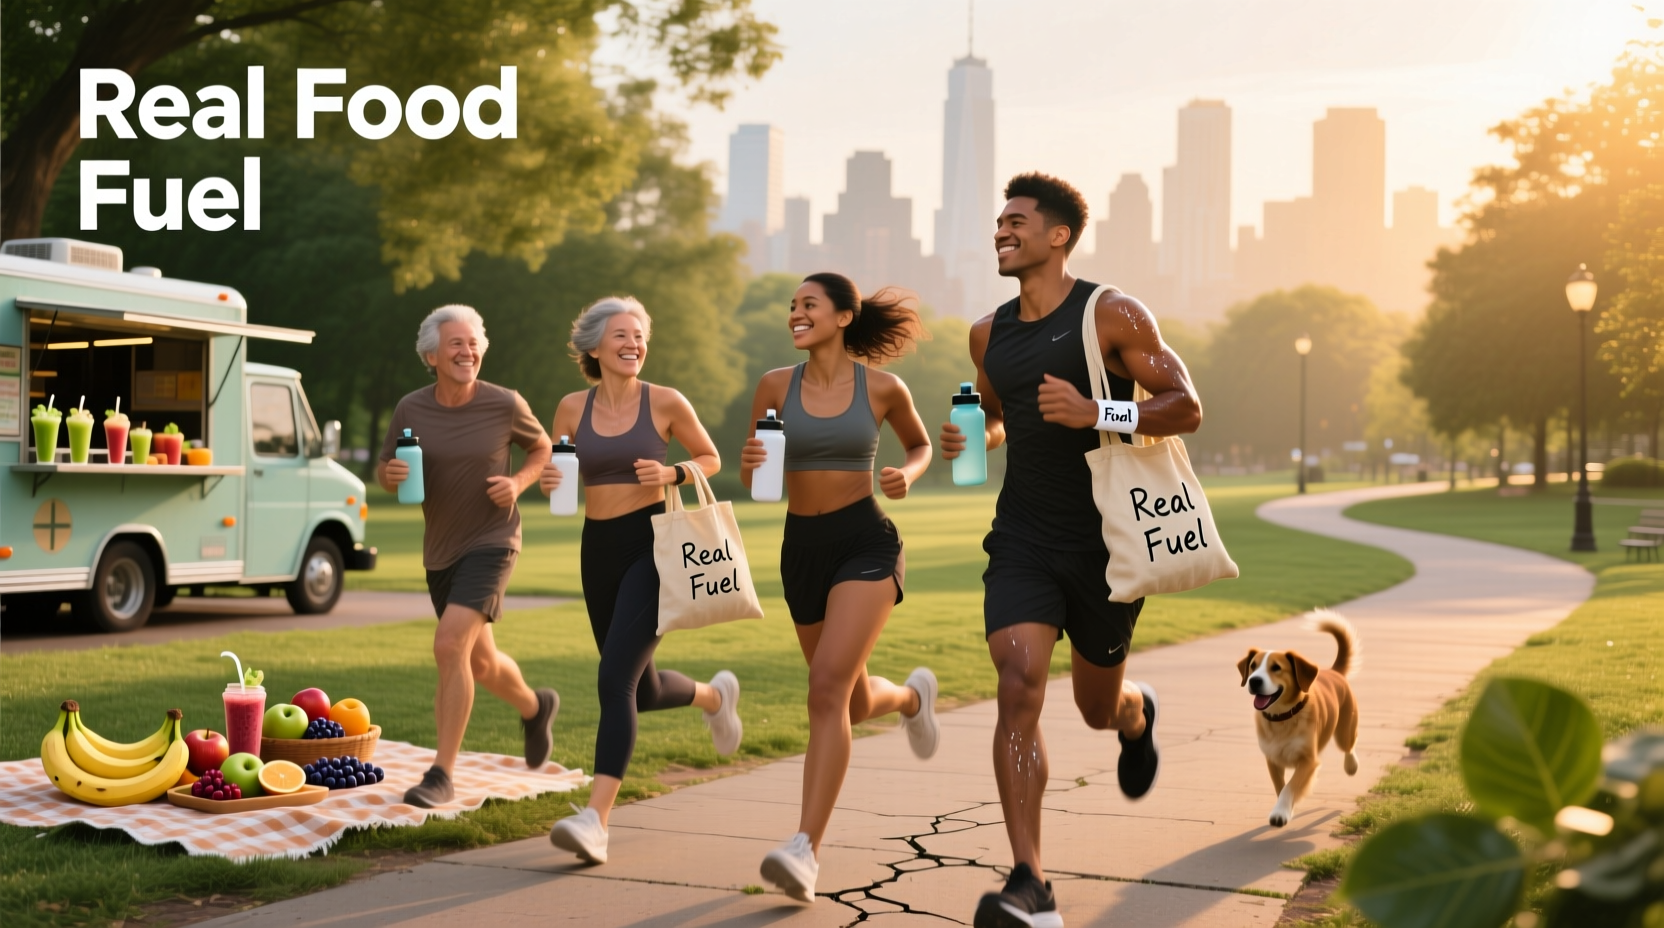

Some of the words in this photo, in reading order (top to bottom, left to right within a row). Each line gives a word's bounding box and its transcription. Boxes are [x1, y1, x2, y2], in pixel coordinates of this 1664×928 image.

[1130, 482, 1195, 521] Real
[682, 539, 733, 569] Real
[1144, 518, 1208, 562] Fuel
[690, 568, 740, 600] Fuel
